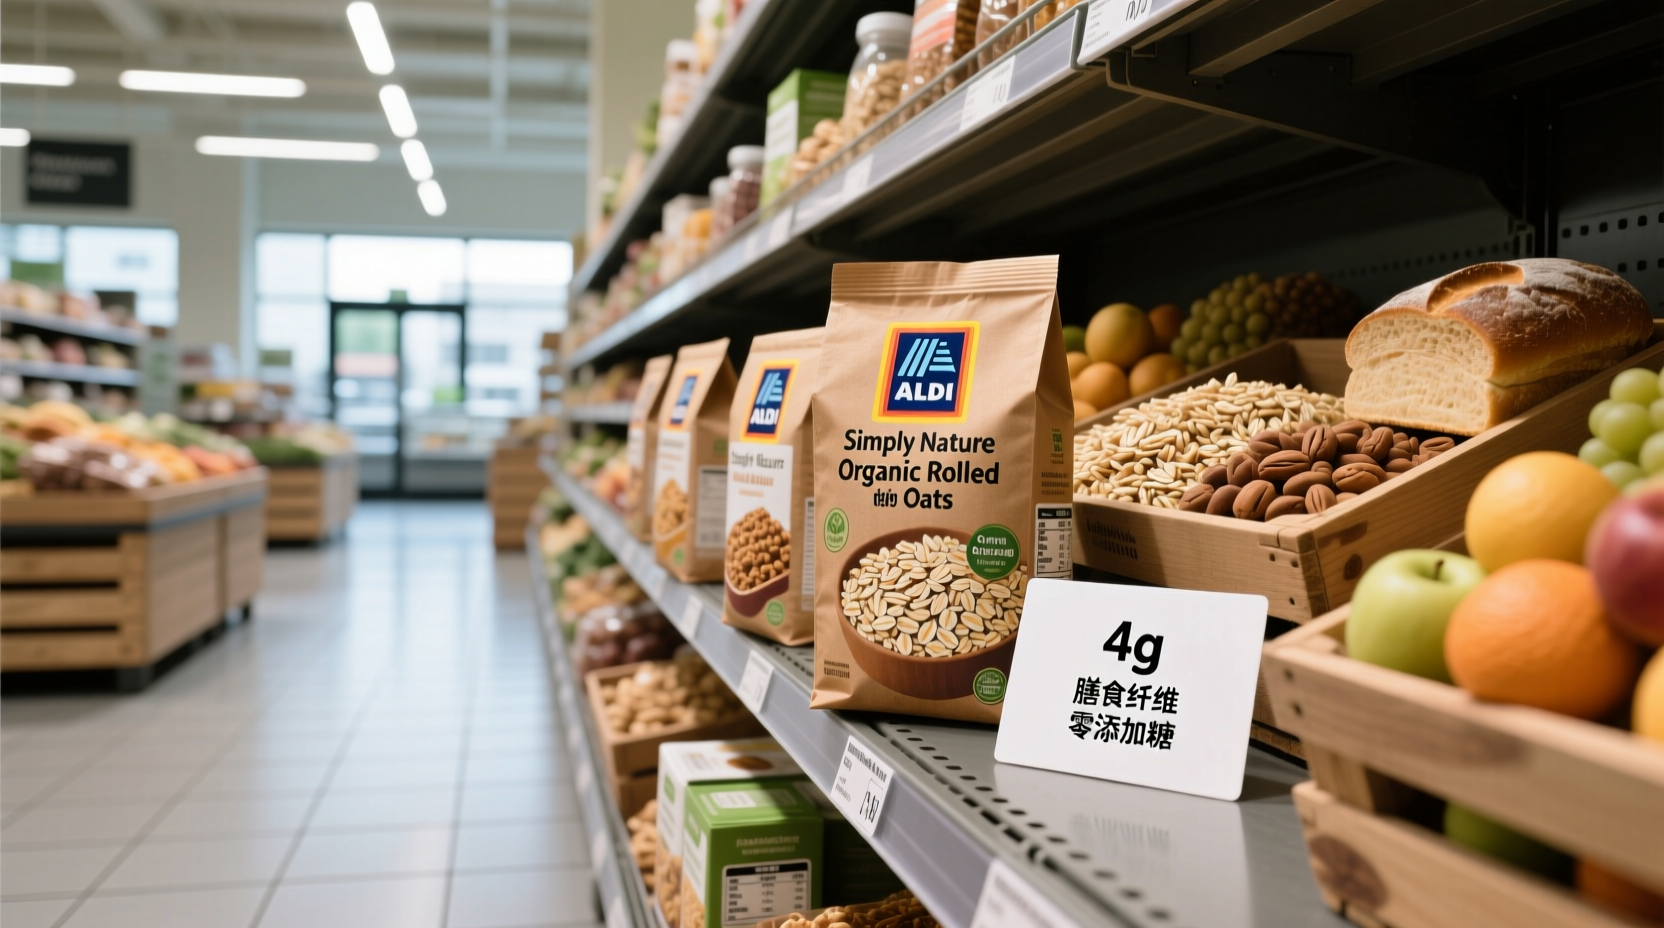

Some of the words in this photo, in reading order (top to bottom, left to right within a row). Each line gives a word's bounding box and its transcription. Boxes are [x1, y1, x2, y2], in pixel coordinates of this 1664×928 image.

[895, 382, 954, 401] ALDI
[749, 407, 780, 426] ALDI
[844, 429, 915, 457] Simply
[920, 432, 995, 454] Nature
[838, 458, 921, 488] Organic
[927, 461, 1000, 485] Rolled
[903, 487, 954, 510] Oats
[1103, 620, 1164, 676] 4g
[1072, 676, 1180, 714] 膳食纤维
[1068, 710, 1177, 750] 零添加糖
